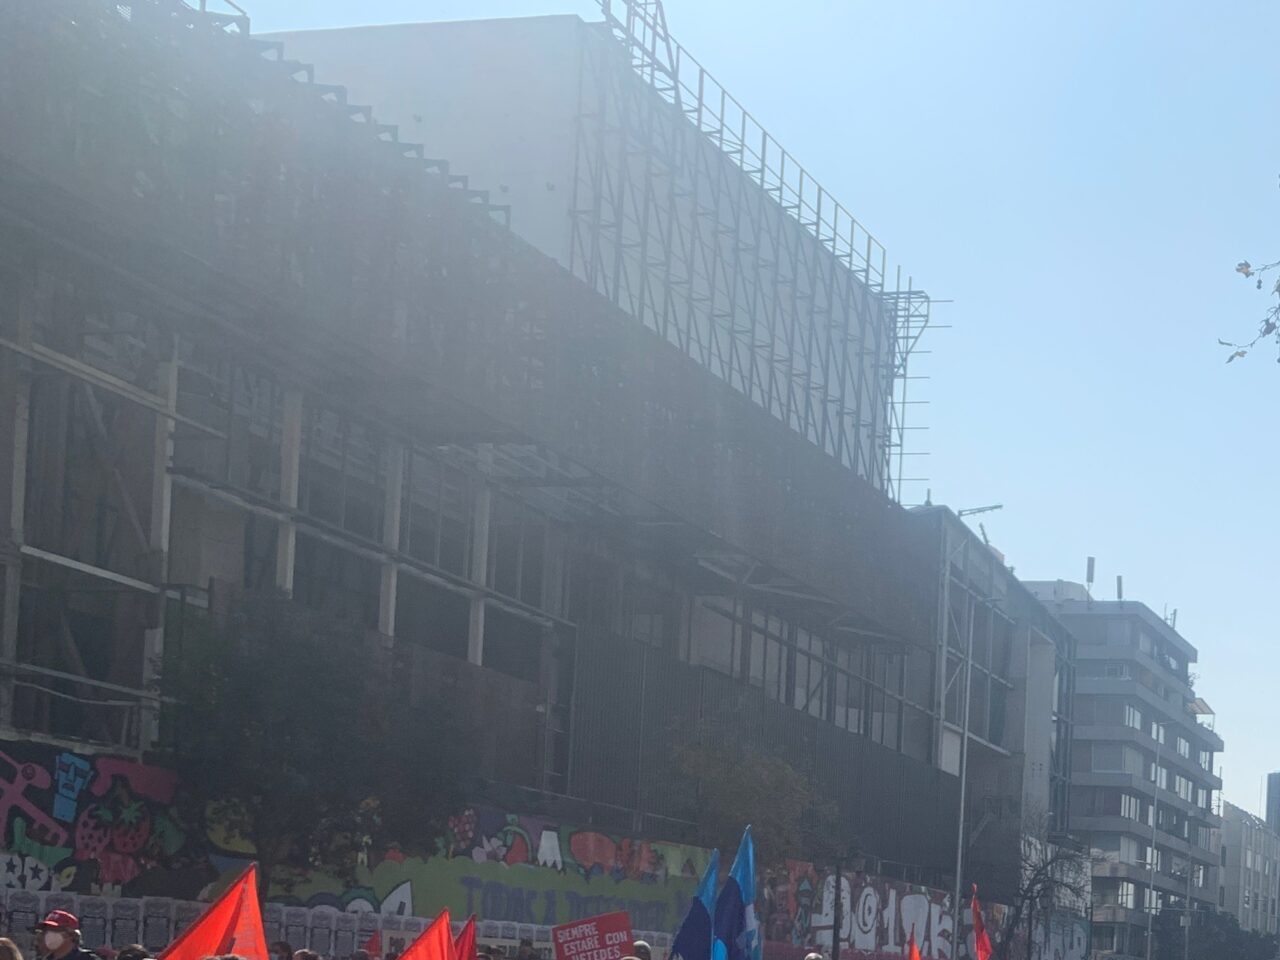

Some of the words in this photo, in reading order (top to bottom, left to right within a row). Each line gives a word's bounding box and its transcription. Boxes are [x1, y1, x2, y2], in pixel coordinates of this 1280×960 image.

[557, 922, 599, 942] SIEMPRE
[563, 936, 601, 956] ESTARE
[605, 931, 628, 945] CON
